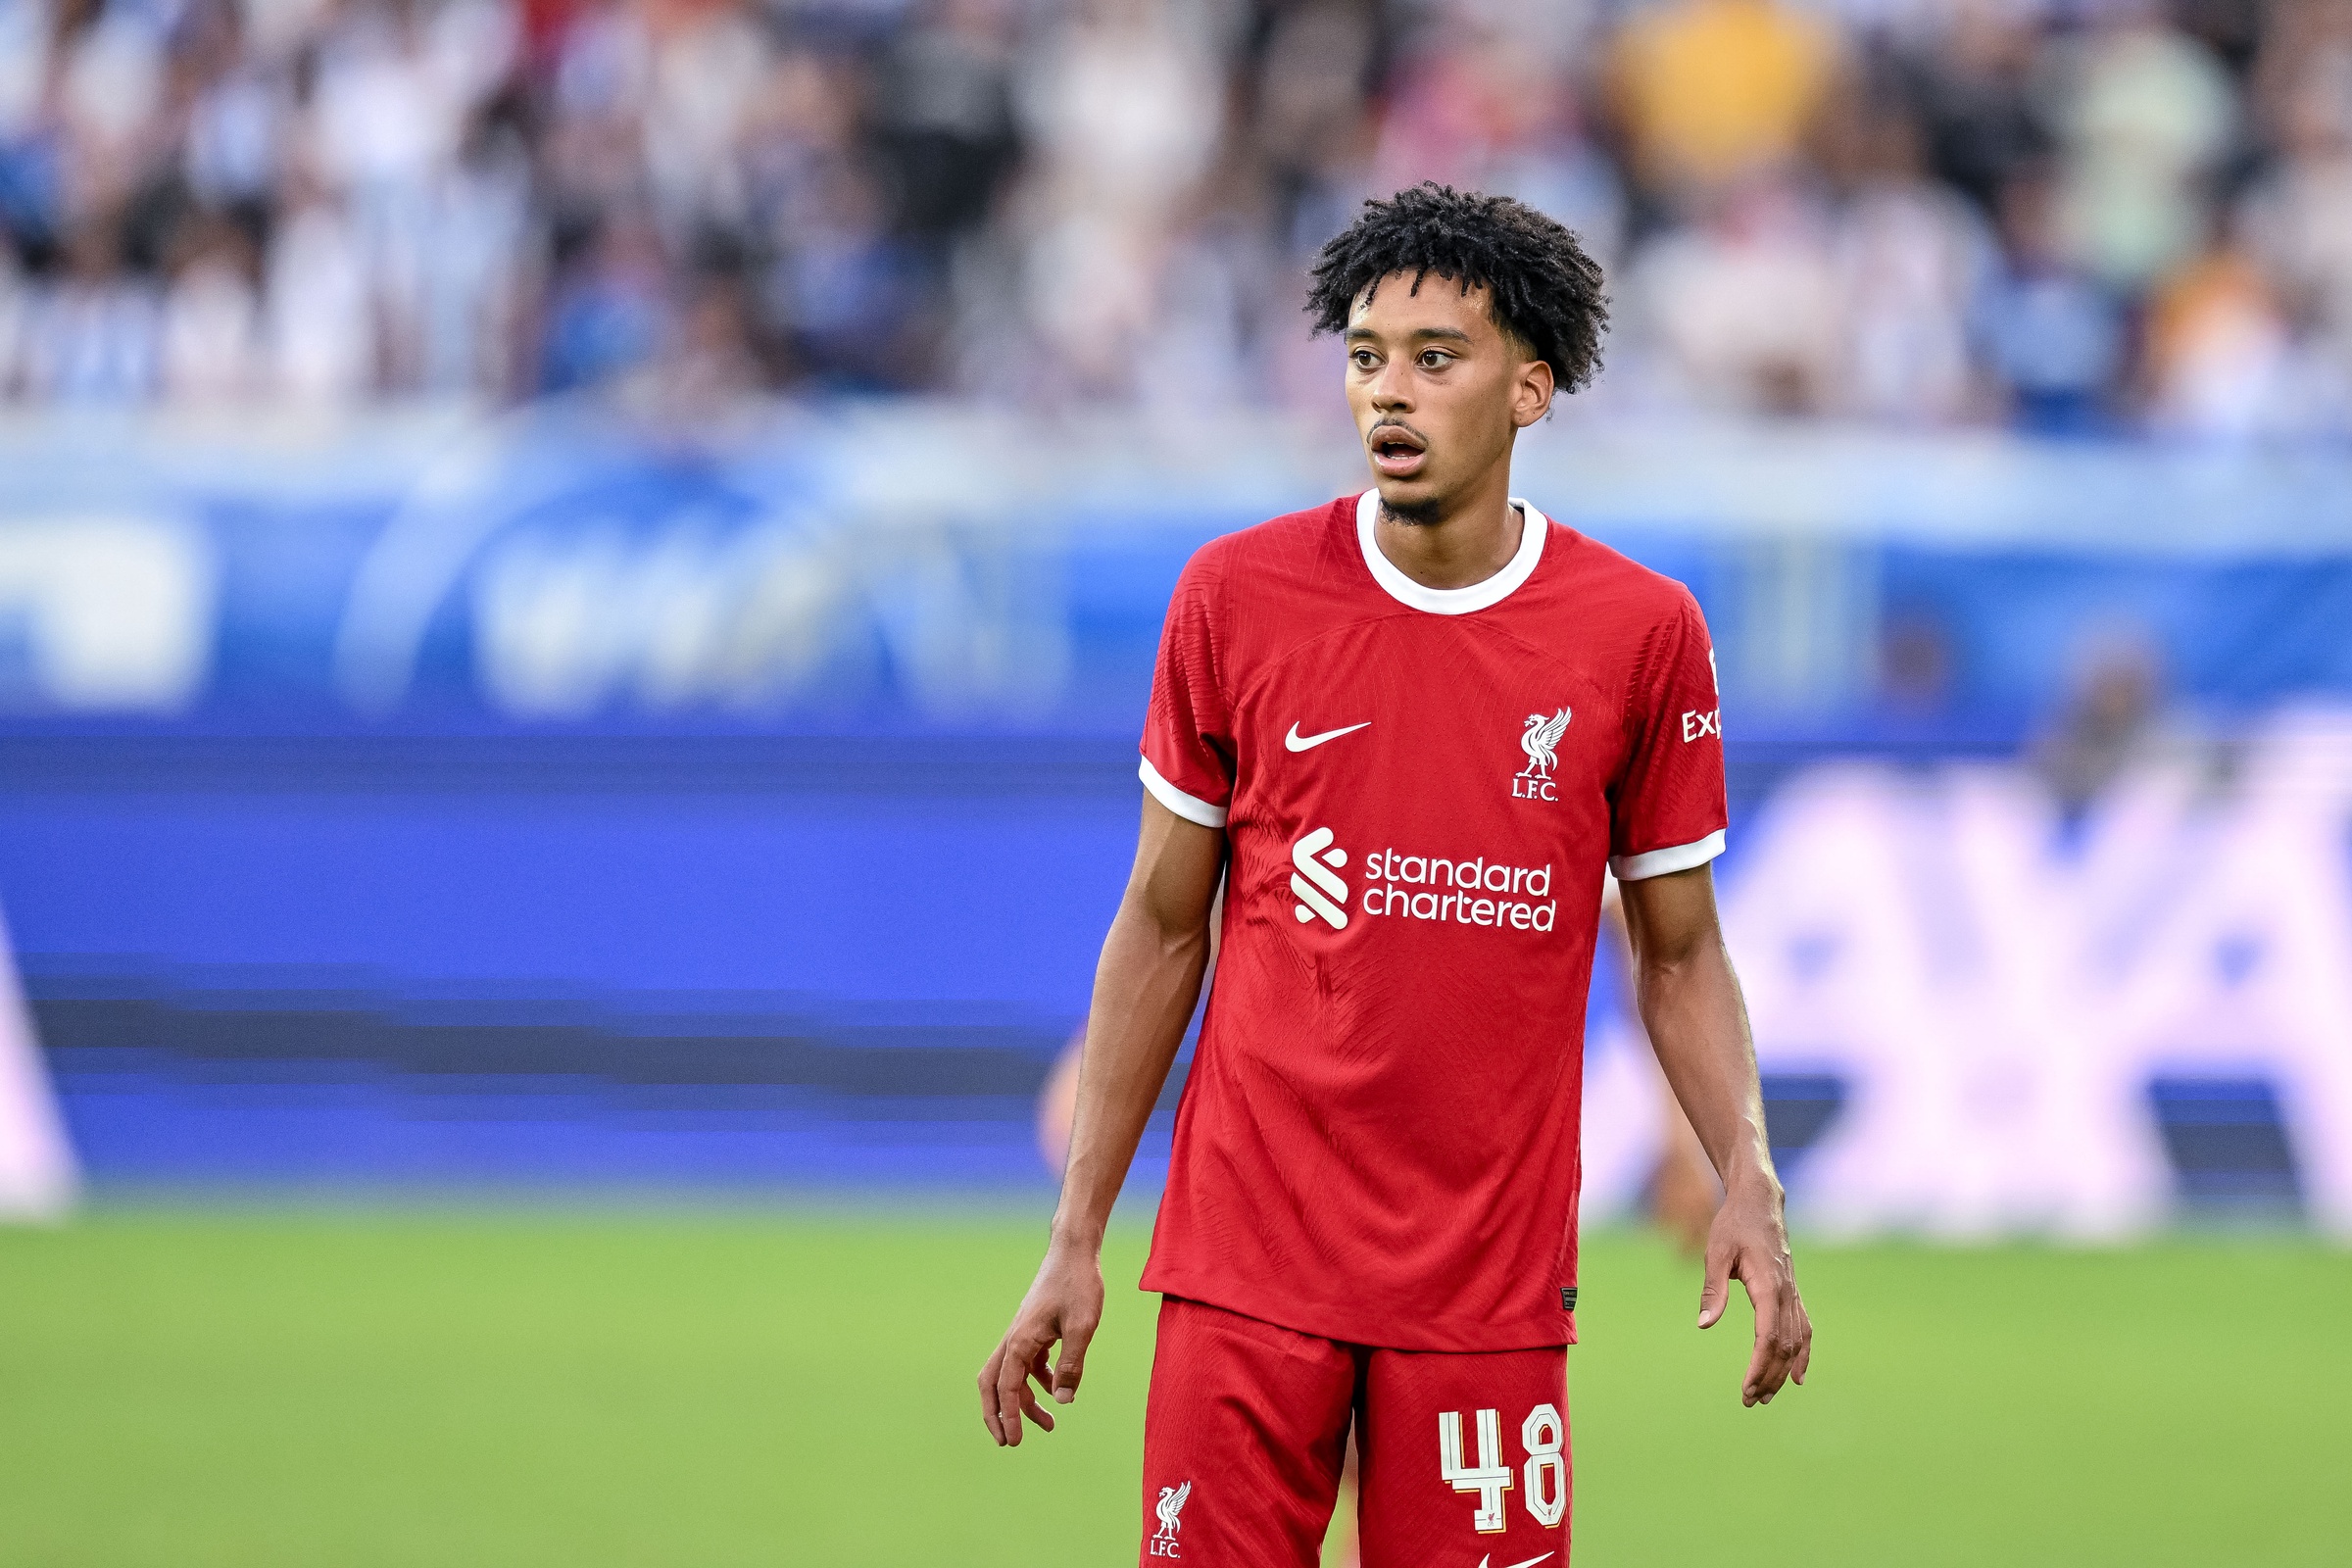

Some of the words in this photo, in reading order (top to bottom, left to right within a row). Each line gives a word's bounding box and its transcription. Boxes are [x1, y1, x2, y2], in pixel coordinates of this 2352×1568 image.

[1511, 778, 1559, 802] L.F.C.
[1365, 847, 1550, 897] standard
[1363, 883, 1556, 932] chartered
[1439, 1403, 1567, 1534] 48
[1150, 1540, 1181, 1558] L.F.C.
